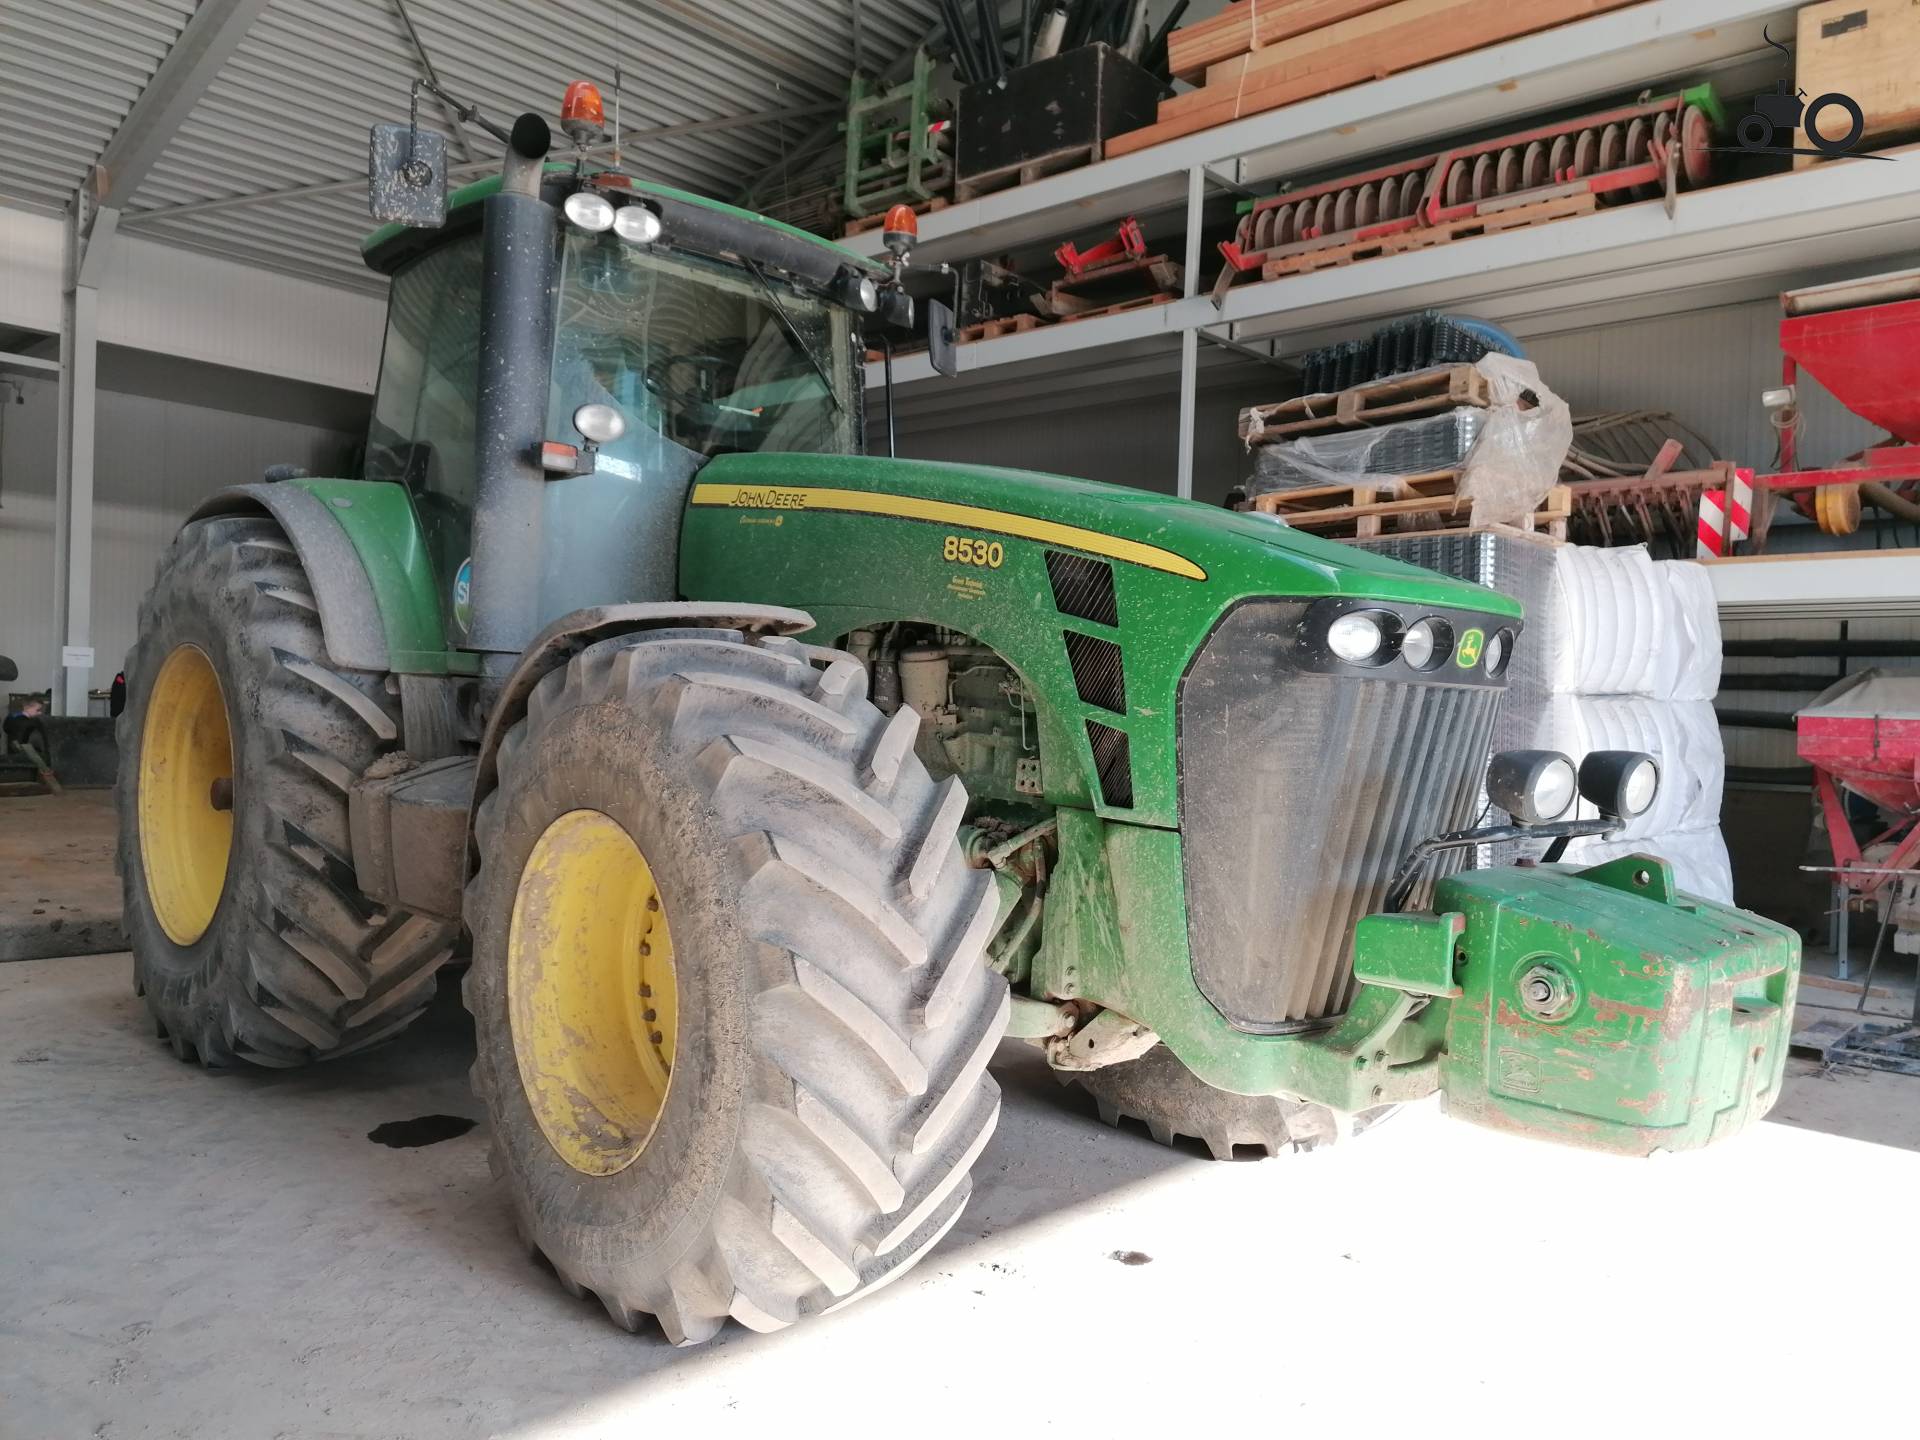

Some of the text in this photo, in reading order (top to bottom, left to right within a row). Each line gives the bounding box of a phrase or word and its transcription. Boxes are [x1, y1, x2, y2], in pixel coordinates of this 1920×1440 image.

[731, 488, 807, 508] JOHN DEERE
[943, 535, 1004, 569] 8530
